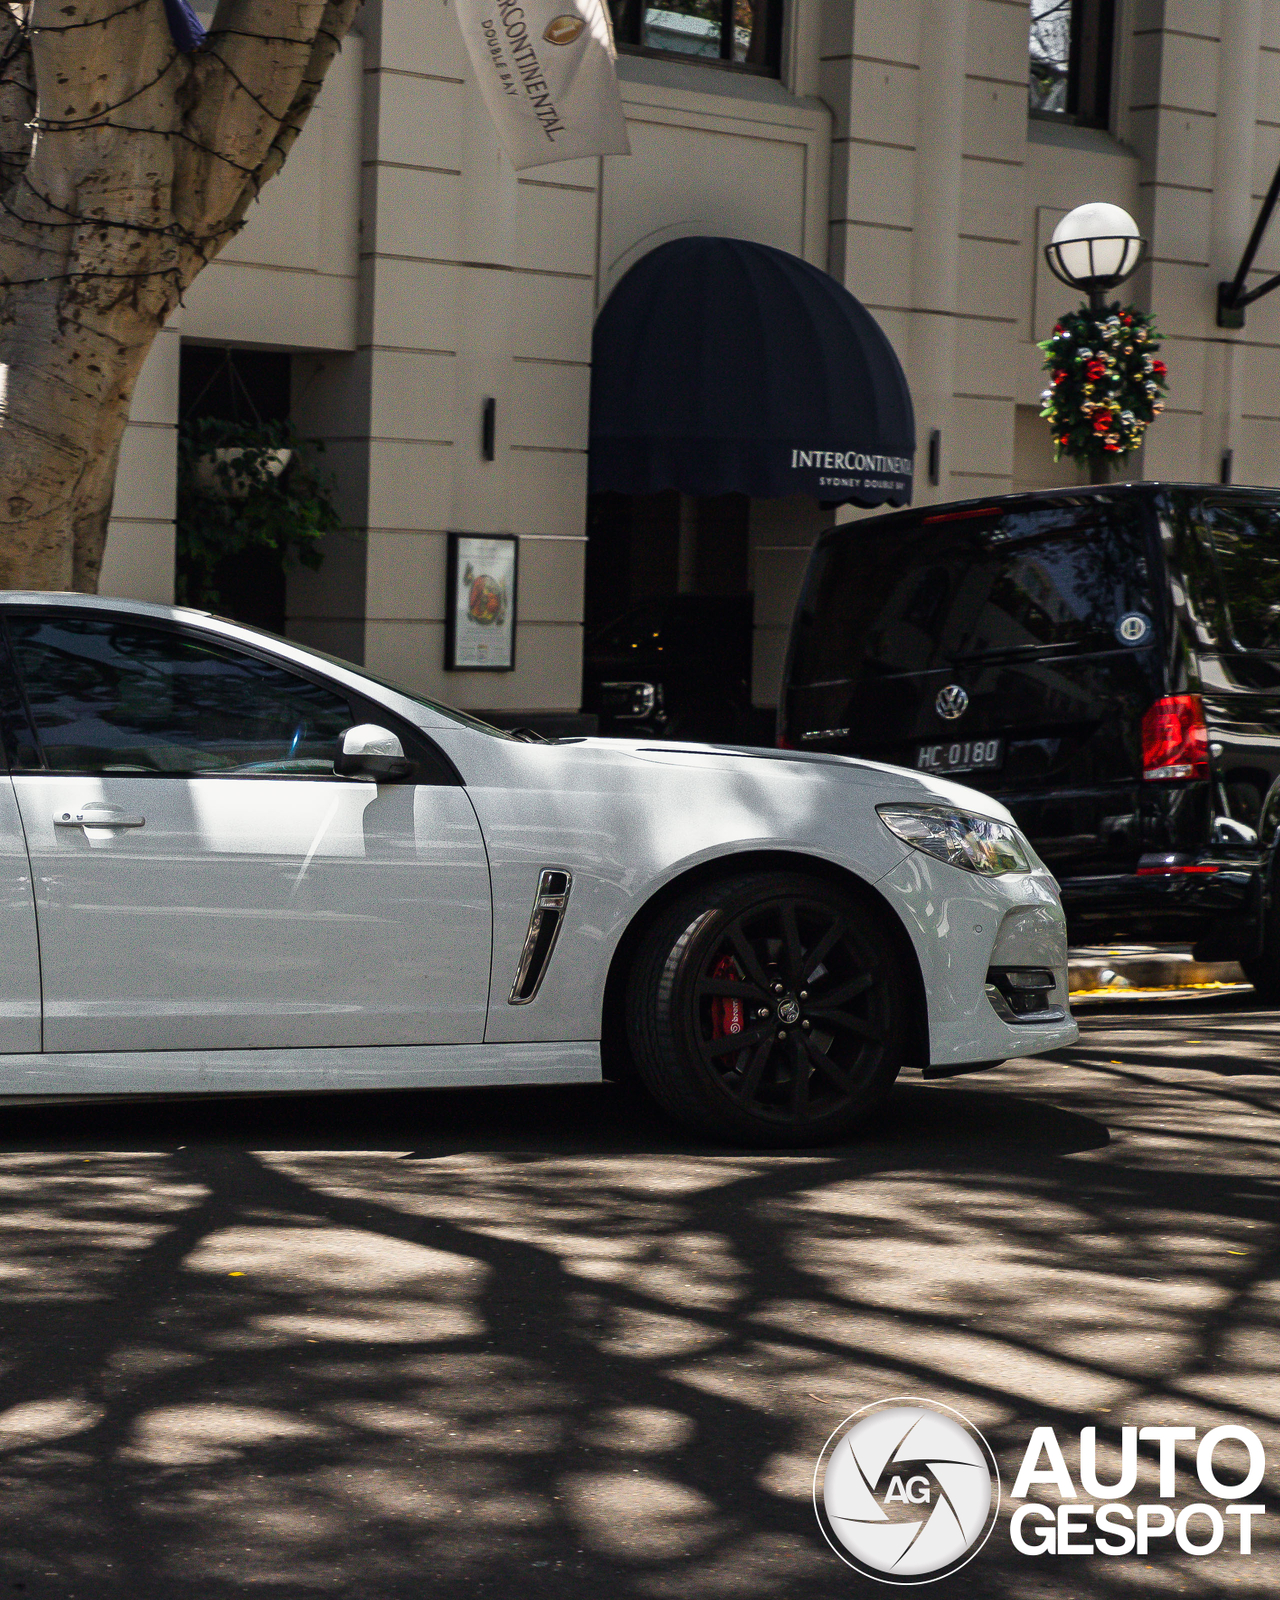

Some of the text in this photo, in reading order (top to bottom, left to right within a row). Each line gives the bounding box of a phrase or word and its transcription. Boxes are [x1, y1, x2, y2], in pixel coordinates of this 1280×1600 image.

[481, 19, 519, 96] DOUBLE BAY
[497, 0, 565, 142] RCONTINENTAL
[819, 476, 861, 487] SYDNEY
[918, 740, 999, 768] HC 0180
